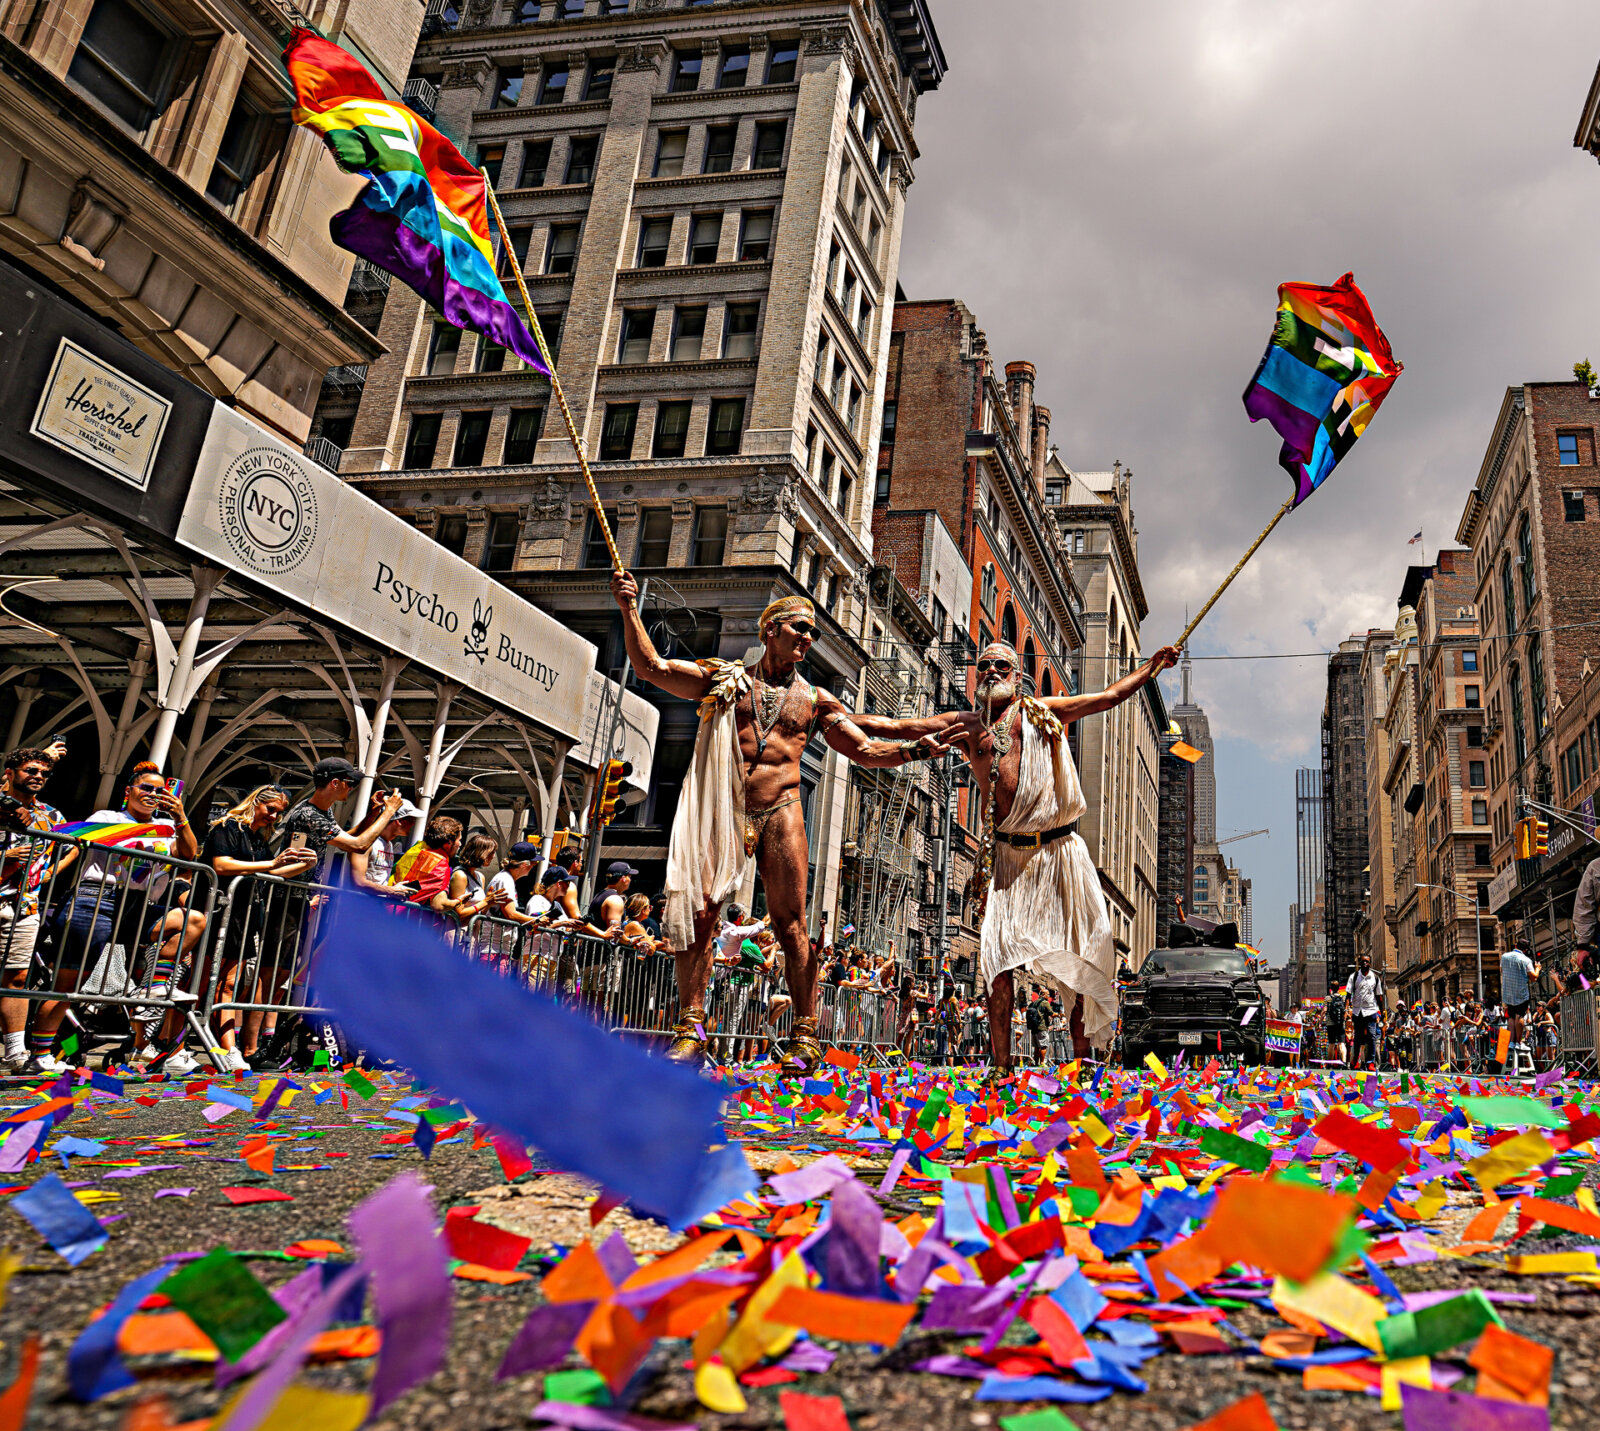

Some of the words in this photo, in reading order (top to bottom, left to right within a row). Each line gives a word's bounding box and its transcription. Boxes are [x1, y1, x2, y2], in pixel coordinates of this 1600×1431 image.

[65, 377, 148, 438] Herschel
[104, 379, 120, 391] FINEST
[120, 388, 137, 407] QUALITY
[79, 429, 98, 445] TRADE
[98, 441, 116, 454] MARK
[84, 415, 100, 428] SUPPLY
[107, 428, 122, 440] BRAND
[236, 455, 262, 479] NEW
[266, 455, 298, 481] YORK
[297, 482, 313, 515] CITY
[246, 488, 295, 532] NYC
[225, 485, 256, 562] PERSONAL
[269, 525, 312, 568] TRAINING
[372, 561, 459, 633] Psycho
[495, 632, 559, 692] Bunny
[1547, 827, 1575, 859] SEPHORA
